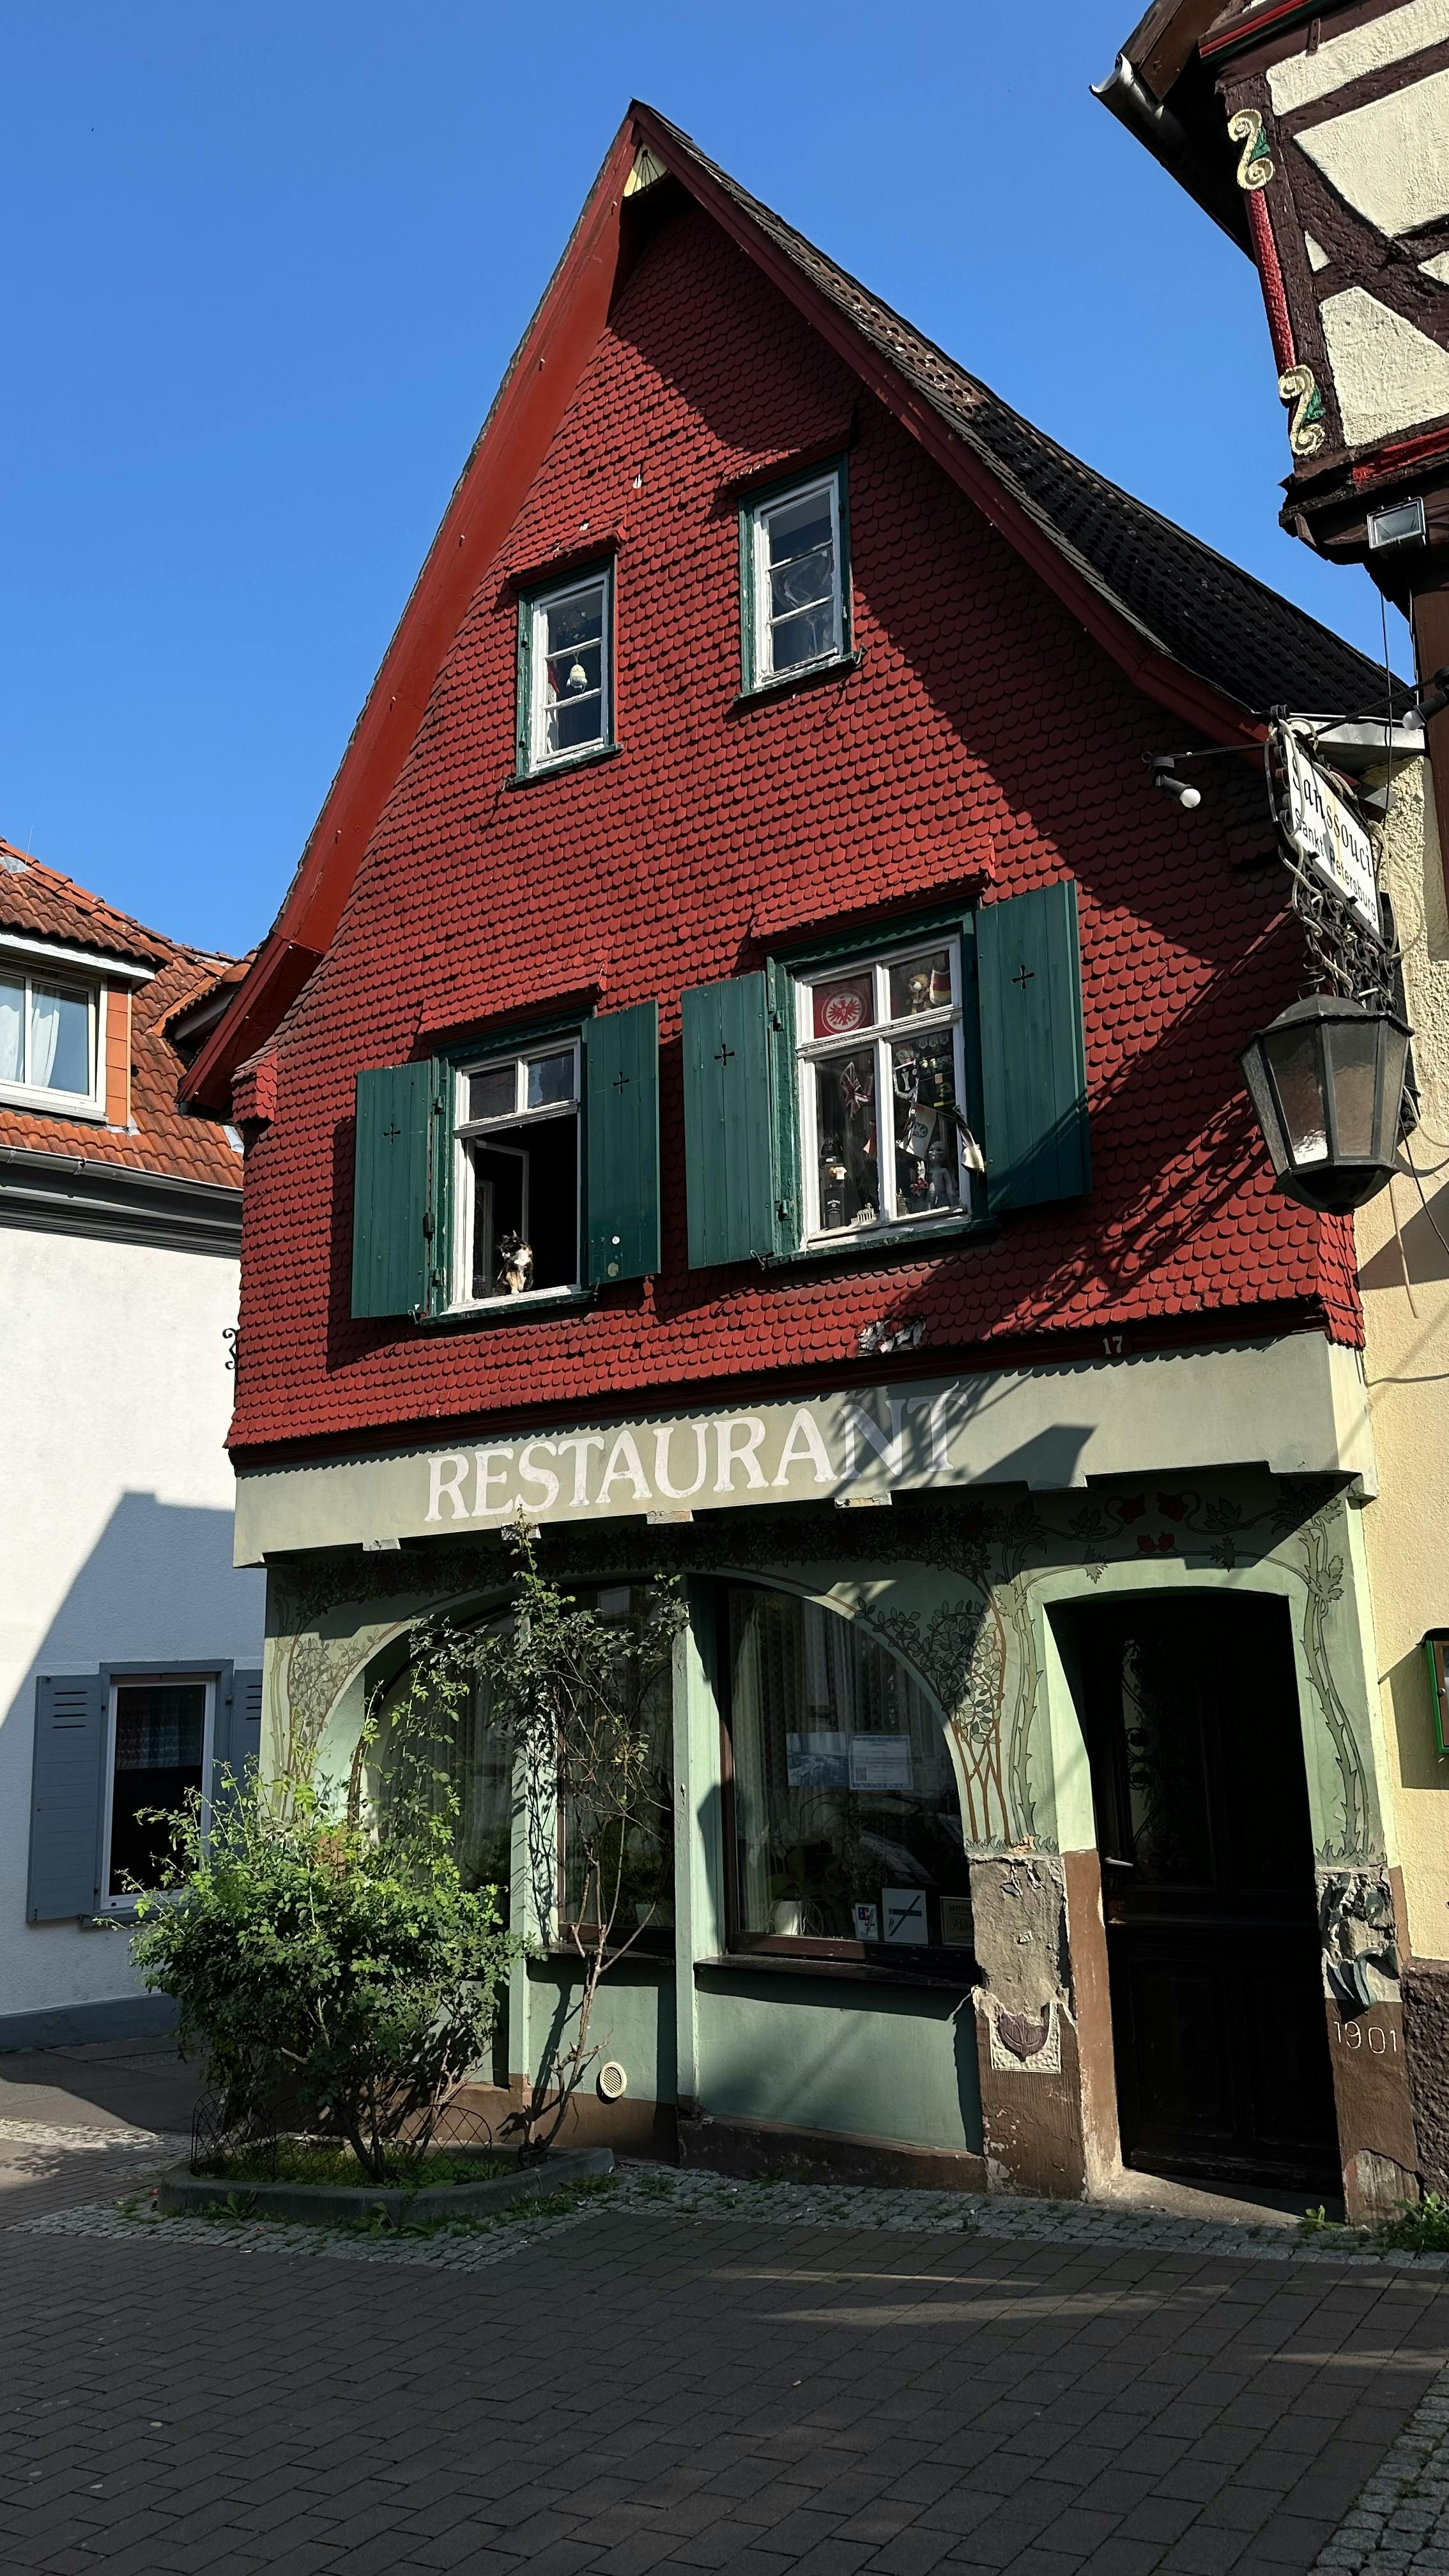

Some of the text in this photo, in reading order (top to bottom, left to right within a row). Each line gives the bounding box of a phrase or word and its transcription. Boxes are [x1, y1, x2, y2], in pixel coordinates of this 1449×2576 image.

[1295, 808, 1376, 922] Sankt Petersburg
[1103, 1335, 1123, 1354] 17
[424, 1381, 967, 1522] RESTAURANT
[1333, 2021, 1397, 2053] 1901
